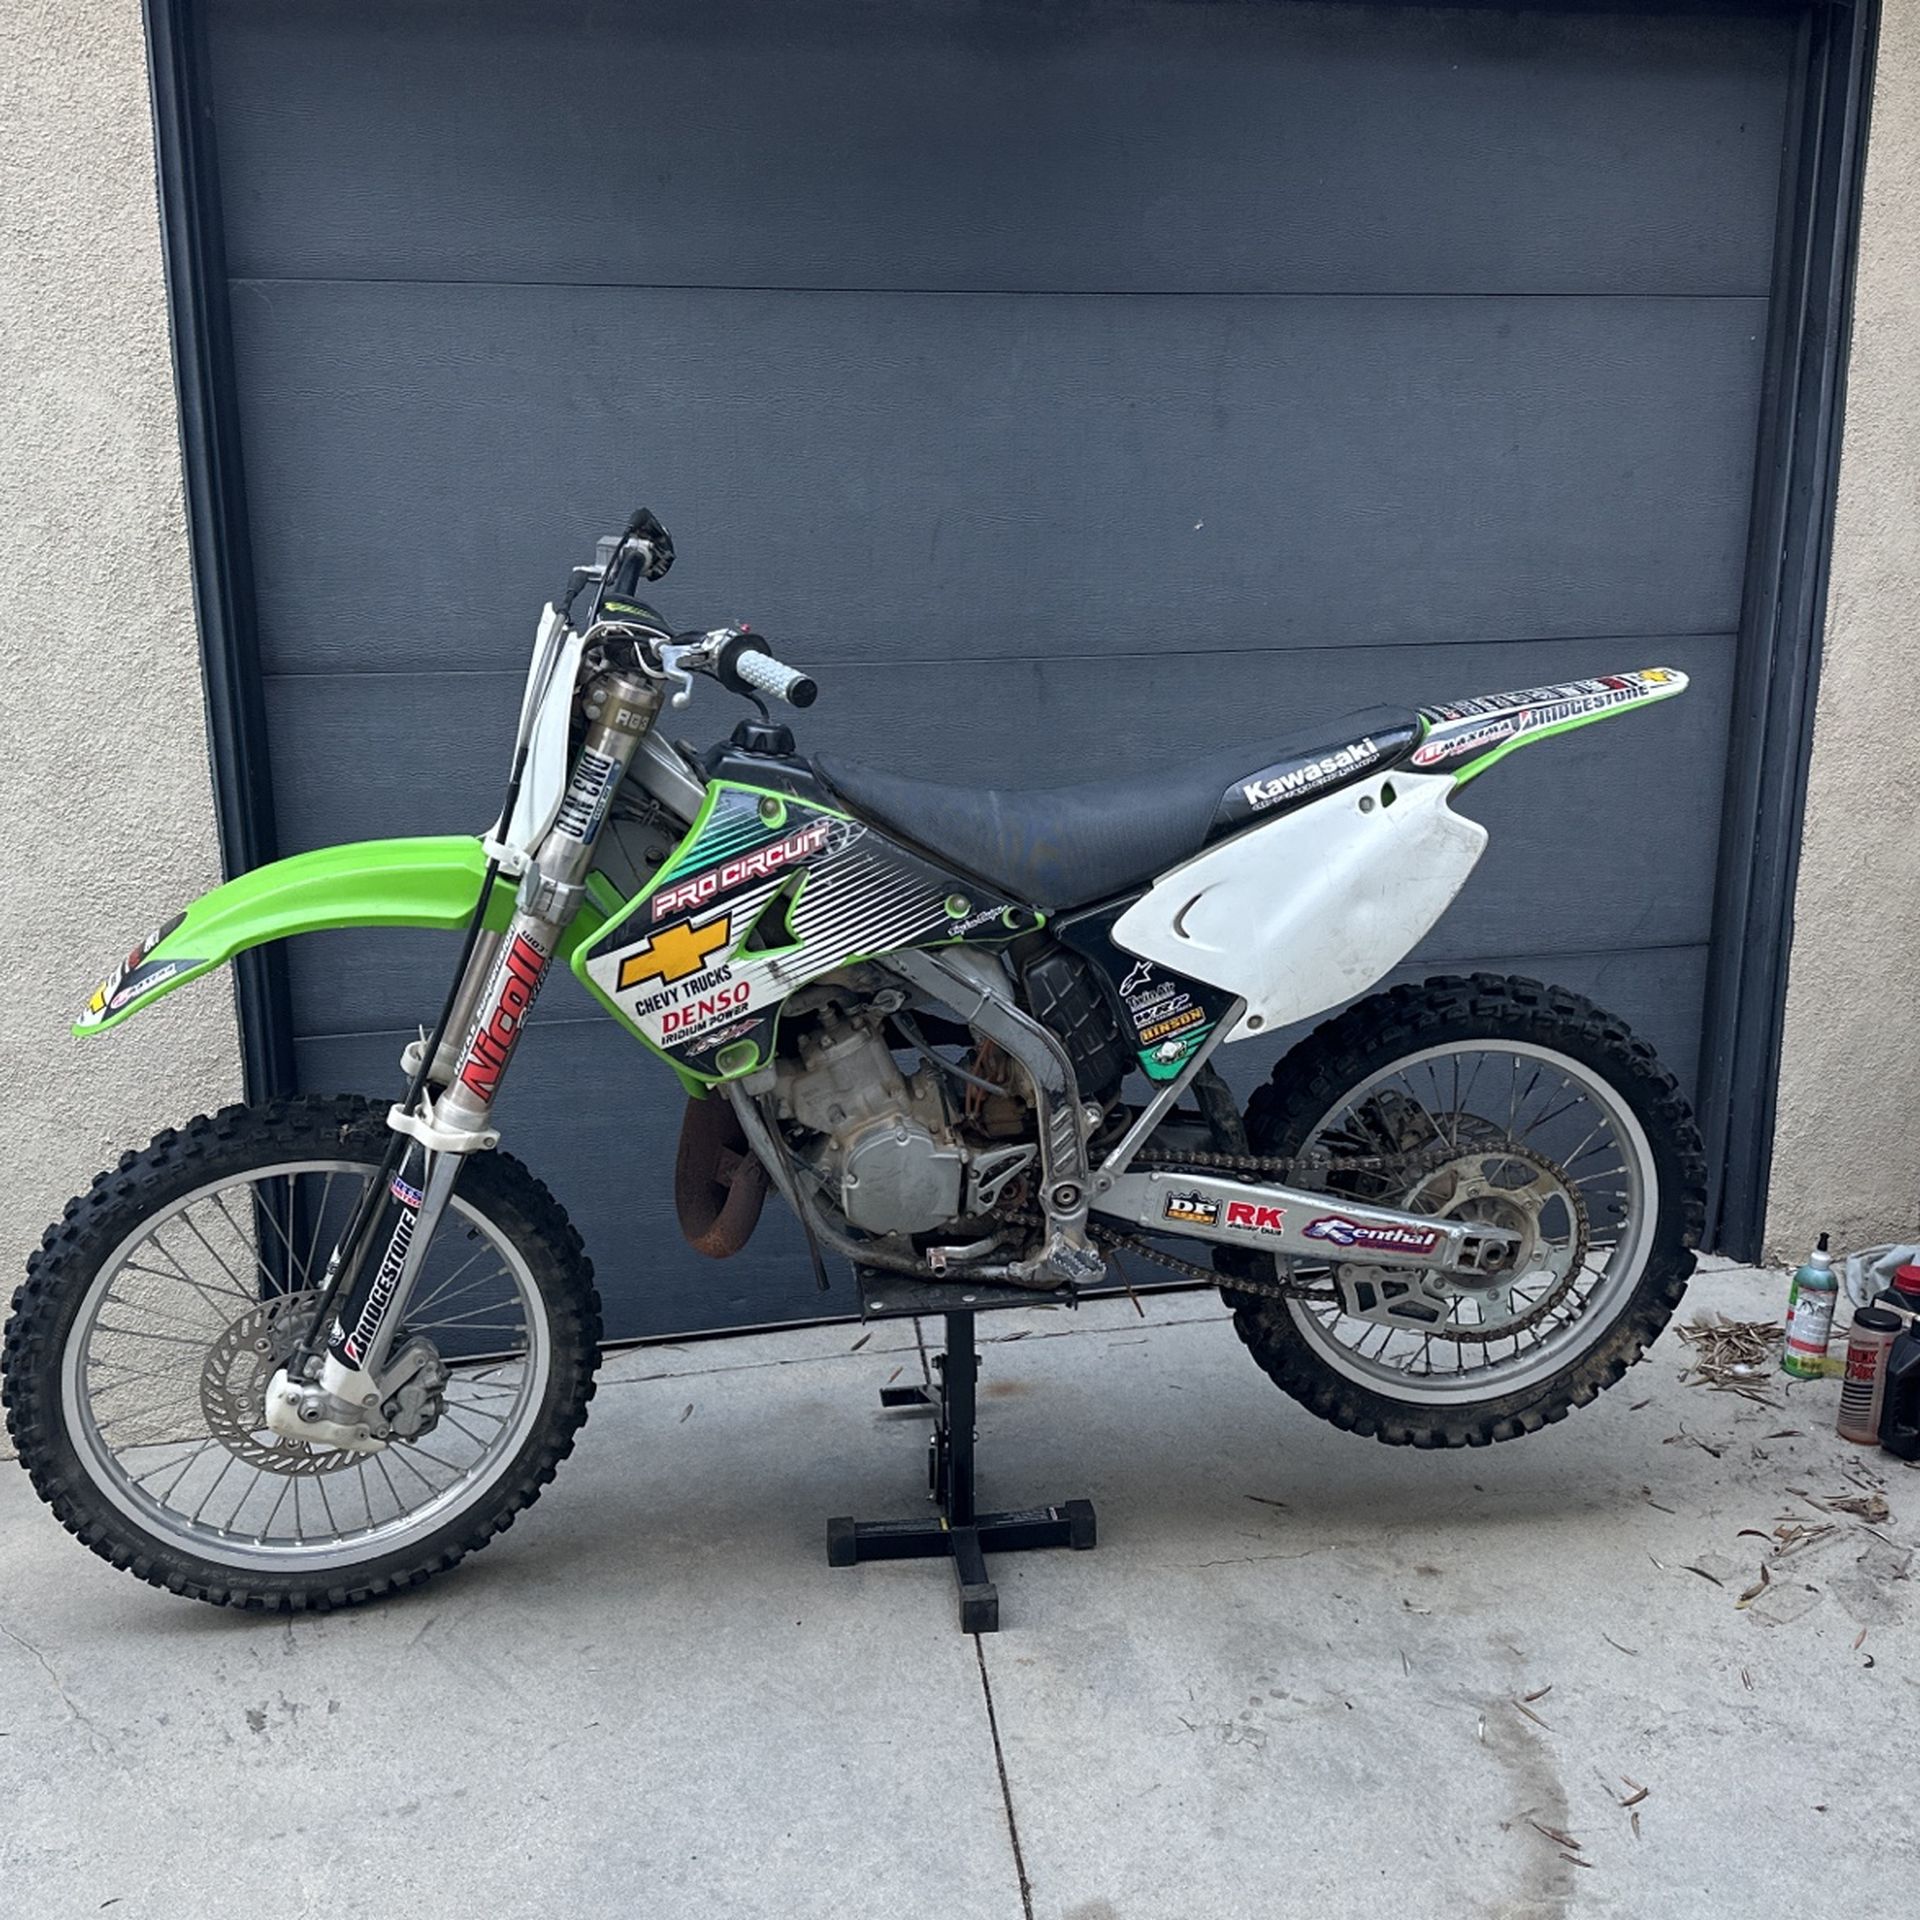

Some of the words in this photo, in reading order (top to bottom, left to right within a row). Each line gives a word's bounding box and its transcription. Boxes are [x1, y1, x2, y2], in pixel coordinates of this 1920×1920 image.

[1519, 685, 1649, 729] BRIDGESTONE
[1243, 737, 1378, 805] Kawasaki
[653, 875, 716, 921] PRO
[722, 826, 827, 885] CIRCUIT
[635, 987, 678, 1016] CHEVY
[681, 964, 732, 998] TRUCKS
[662, 981, 750, 1034] DENSO
[460, 934, 546, 1103] Nicoll
[661, 1020, 706, 1045] IRIDIUM
[710, 1002, 749, 1026] POWER
[1142, 1009, 1201, 1041] HINSON
[1170, 1199, 1217, 1215] DP
[1227, 1202, 1285, 1228] RK
[1309, 1219, 1435, 1245] Renthal
[345, 1207, 417, 1369] BRIDGESTONE
